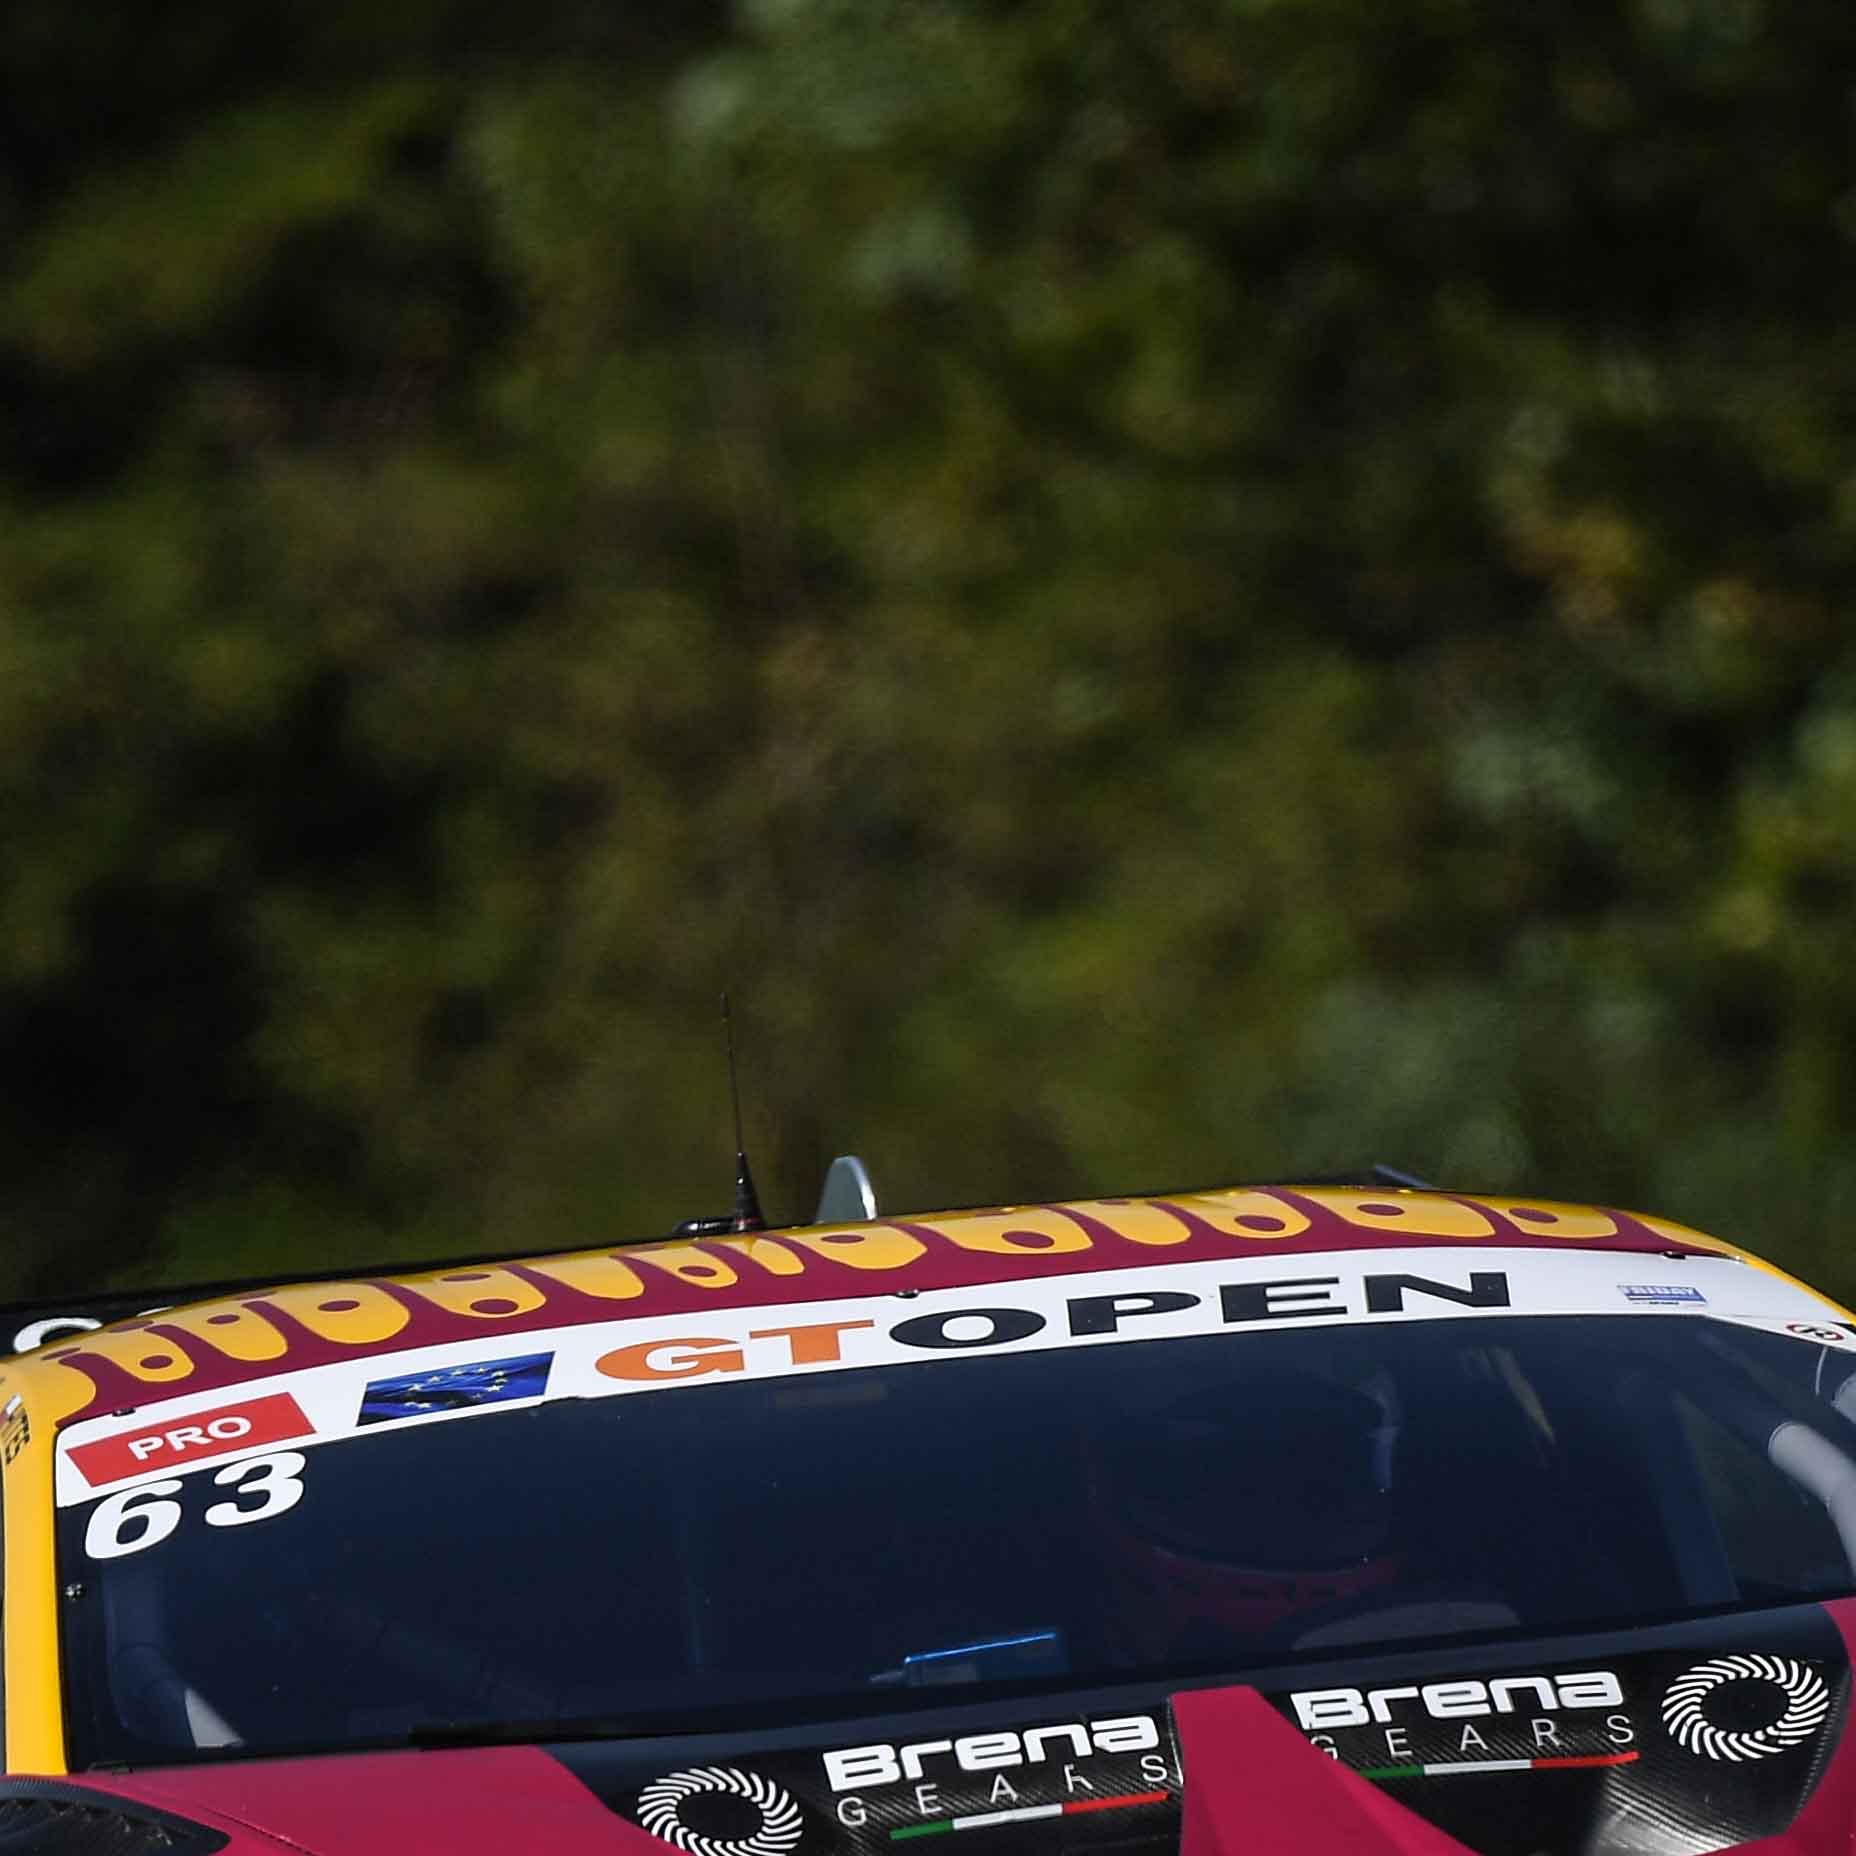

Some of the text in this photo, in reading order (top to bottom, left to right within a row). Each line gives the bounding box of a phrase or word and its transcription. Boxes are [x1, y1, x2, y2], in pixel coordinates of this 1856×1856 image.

[128, 1415, 252, 1461] PRO
[85, 1451, 306, 1559] 63
[1291, 1671, 1624, 1731] Brena
[823, 1715, 1160, 1791] Brena
[1310, 1714, 1636, 1762] GEARS
[837, 1755, 1168, 1827] GEARS
